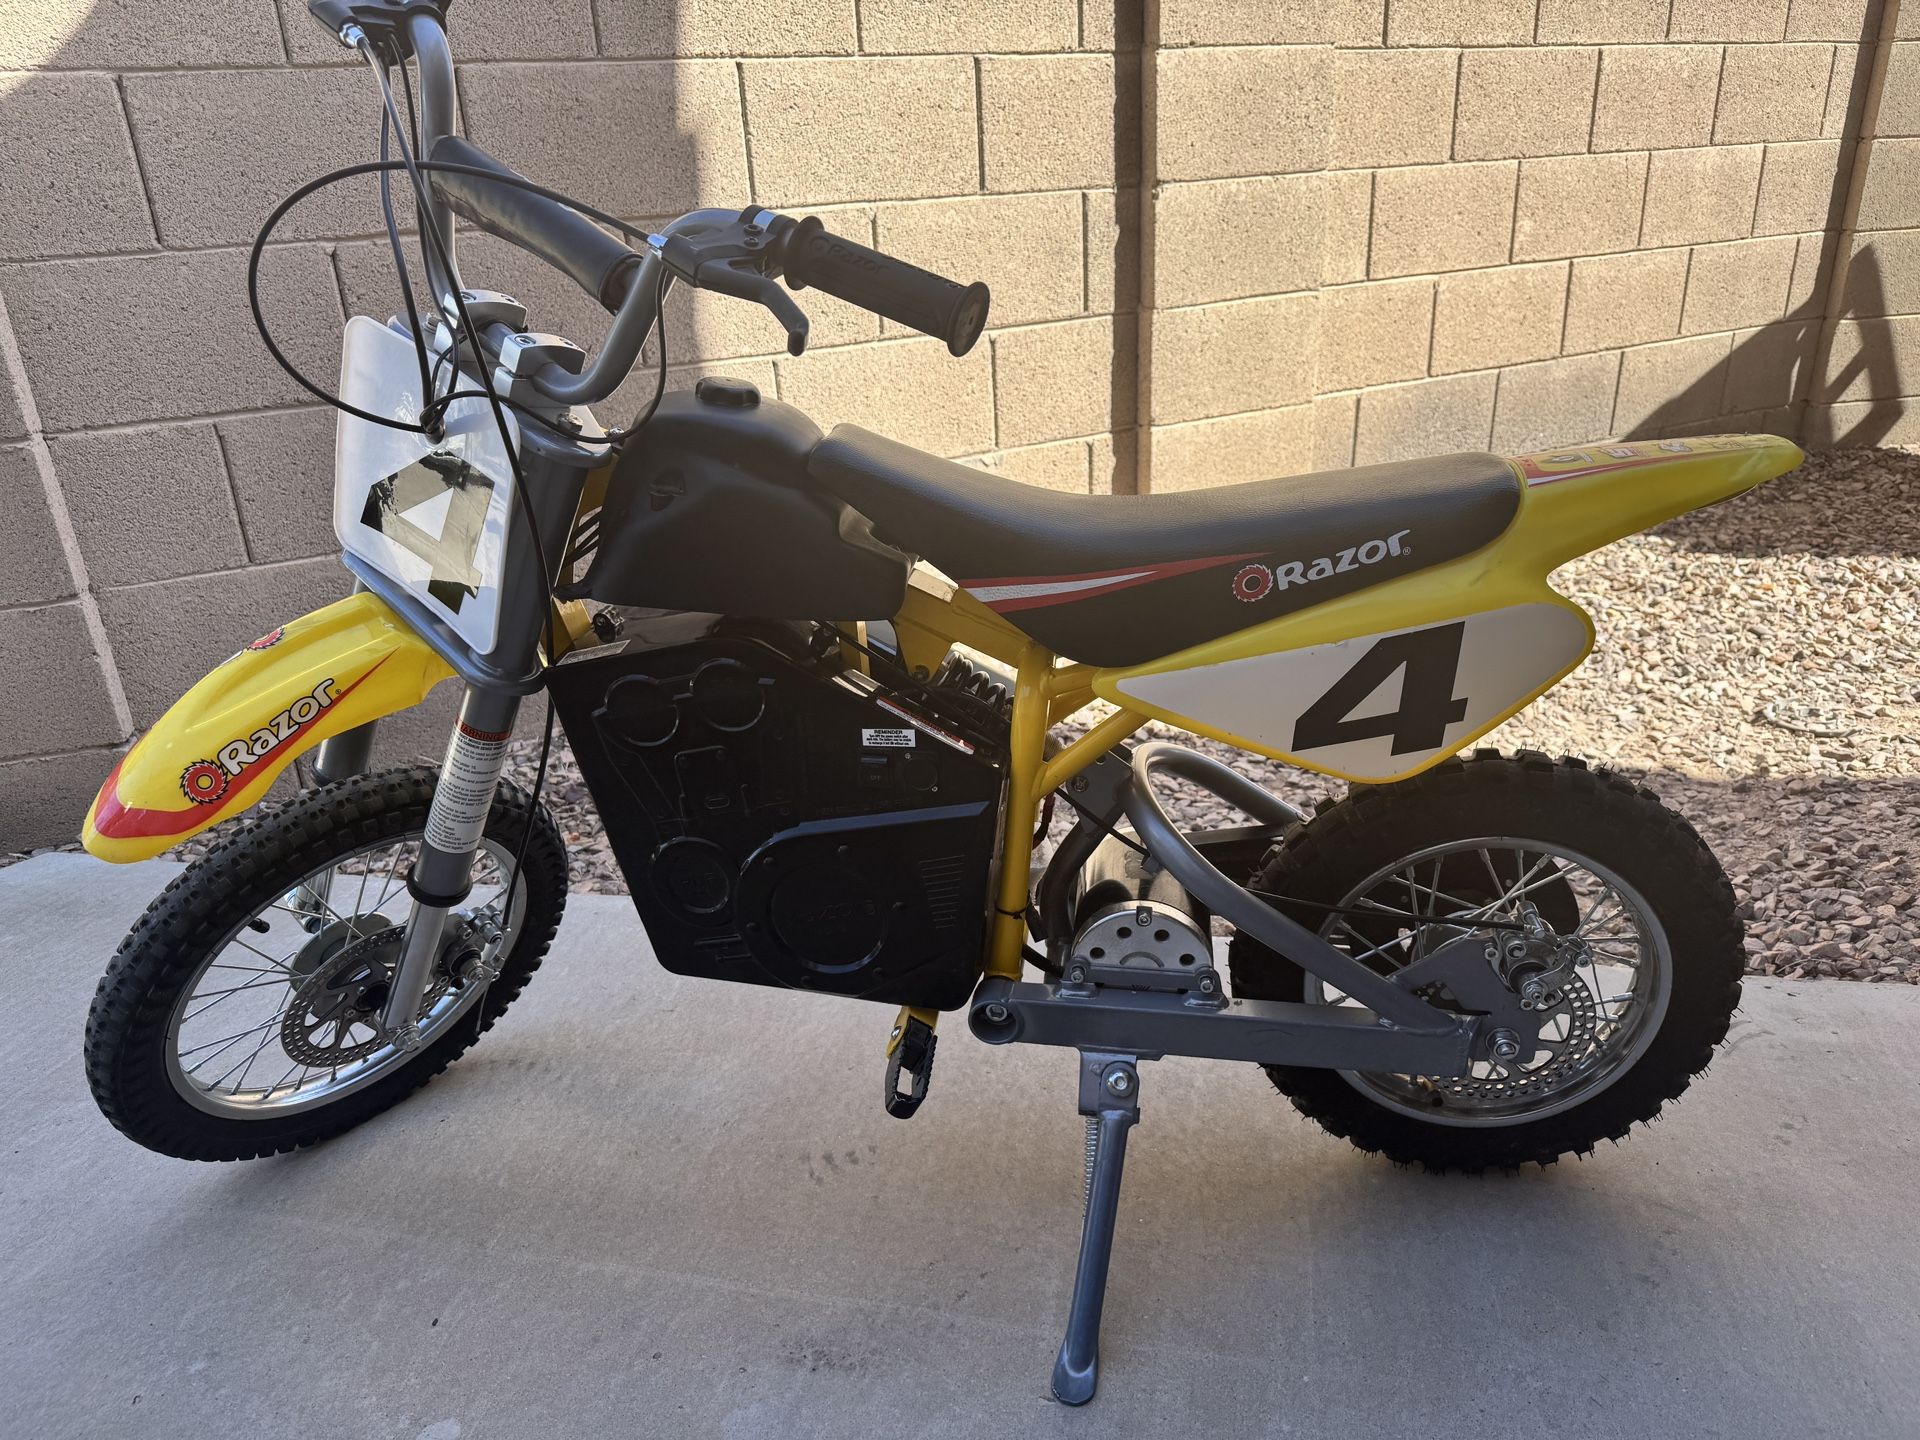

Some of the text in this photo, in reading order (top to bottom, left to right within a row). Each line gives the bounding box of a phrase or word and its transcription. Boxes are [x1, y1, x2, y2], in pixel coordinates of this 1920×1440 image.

[360, 451, 495, 615] 4
[1276, 529, 1411, 591] Razor
[217, 678, 334, 776] Razor
[1291, 621, 1468, 756] 4
